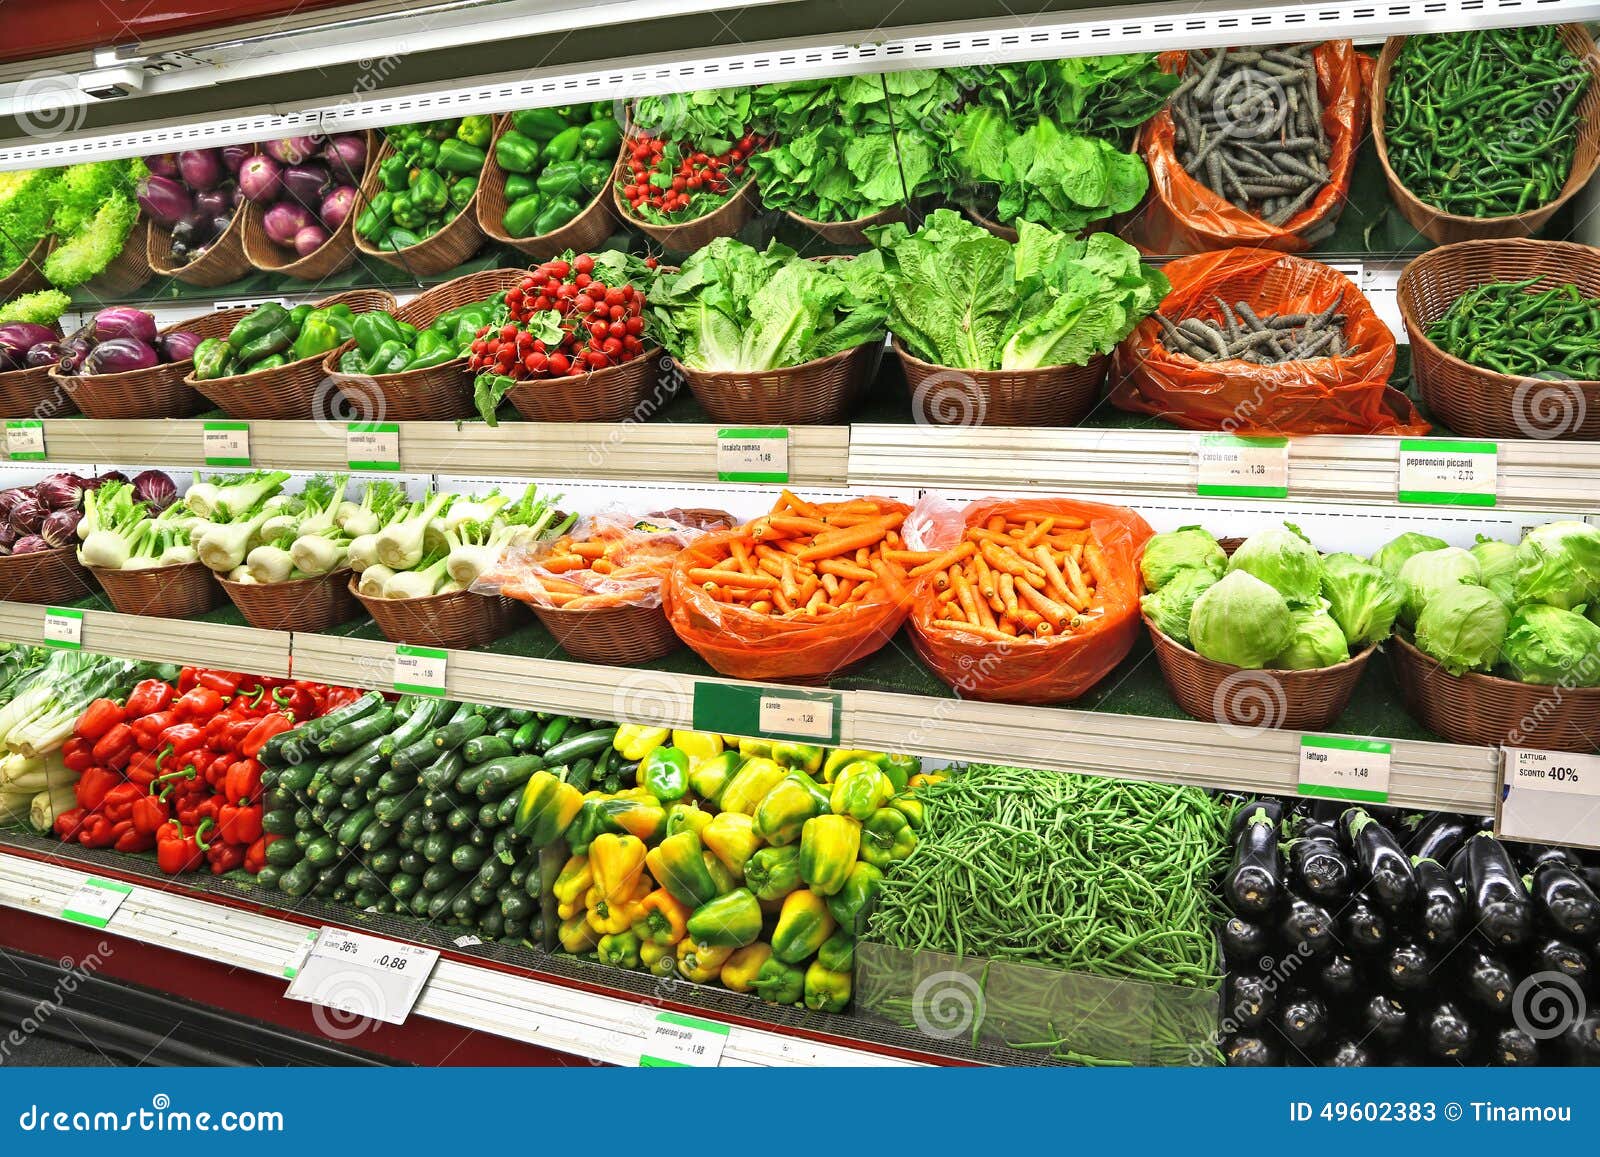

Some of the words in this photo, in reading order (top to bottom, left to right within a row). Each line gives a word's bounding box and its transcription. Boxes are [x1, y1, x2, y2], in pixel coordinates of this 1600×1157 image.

[1406, 457, 1445, 467] peperoncini
[1446, 457, 1473, 468] piccanti
[1306, 752, 1328, 762] lattuga
[1519, 753, 1547, 761] LATTUGA
[1354, 768, 1368, 777] 1,48
[1519, 768, 1546, 778] SCONTO
[1548, 766, 1579, 782] 40%
[339, 941, 360, 954] 36%
[379, 954, 407, 970] 0,88
